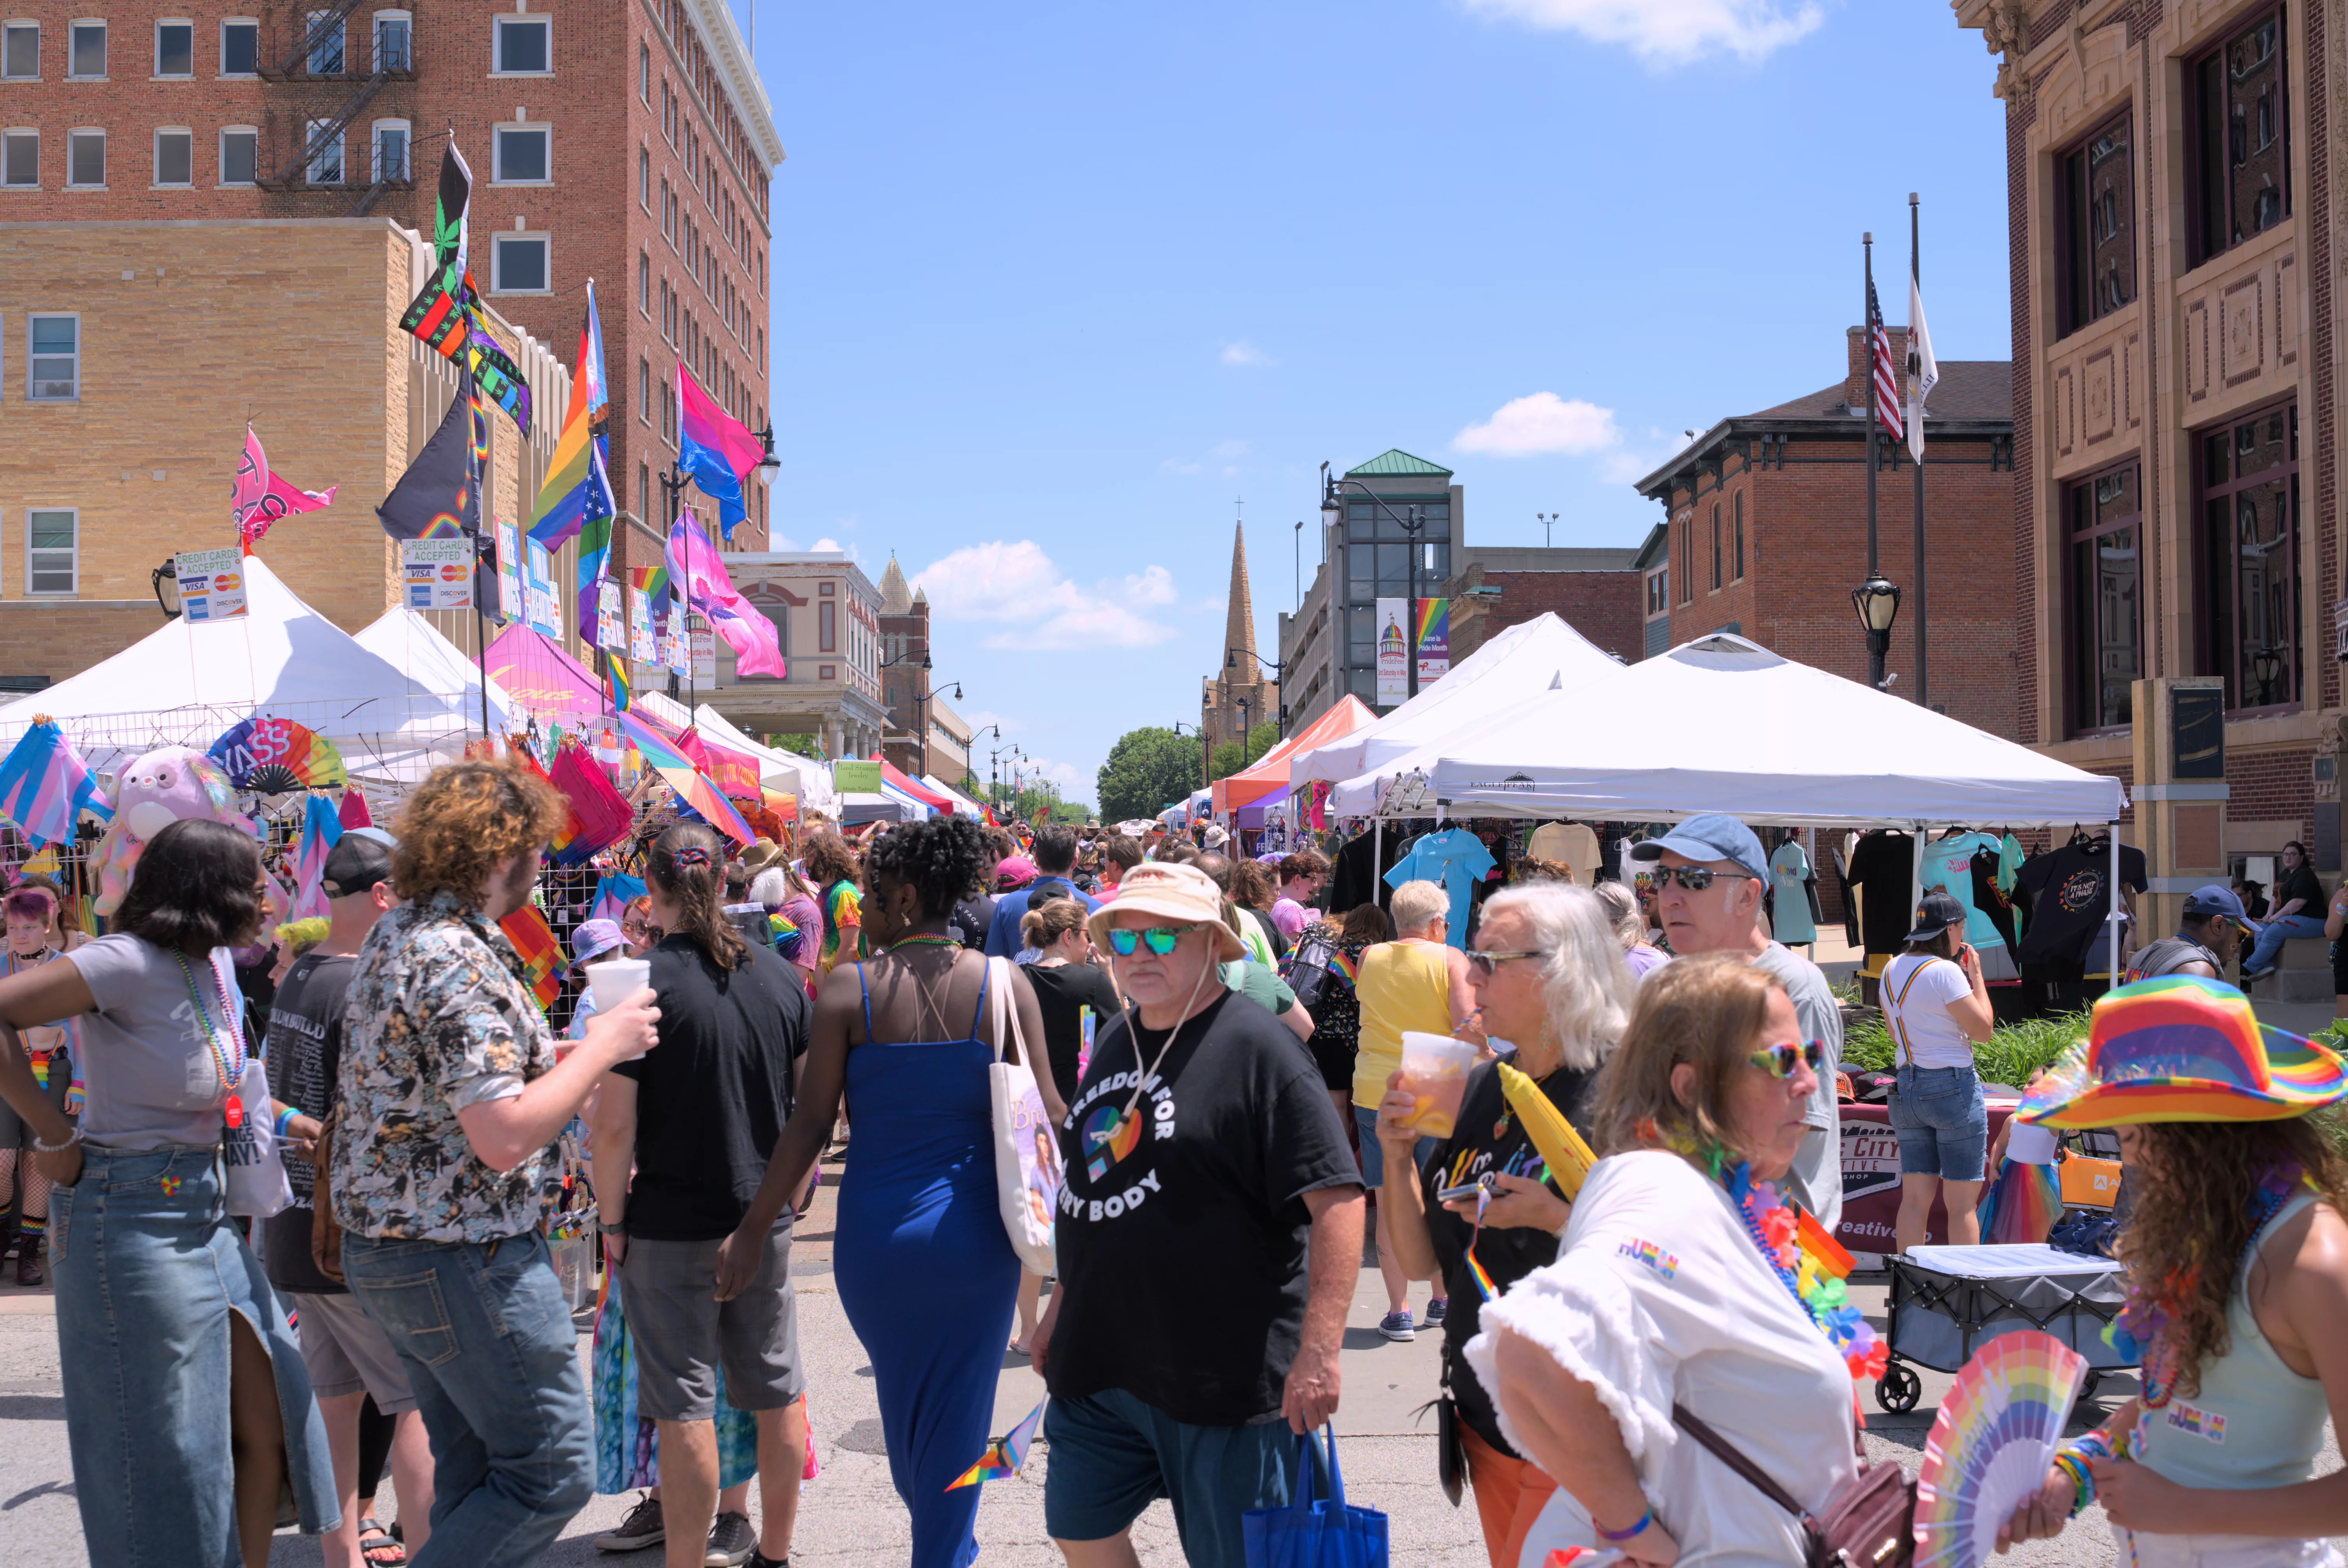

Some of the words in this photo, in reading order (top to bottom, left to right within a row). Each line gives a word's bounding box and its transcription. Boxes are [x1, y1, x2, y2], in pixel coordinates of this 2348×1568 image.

[406, 541, 437, 550] CREDIT
[440, 540, 468, 550] CARDS
[498, 521, 517, 568] FREE
[177, 553, 207, 565] CREDIT
[209, 549, 238, 561] CARDS
[415, 551, 460, 560] ACCEPTED
[187, 561, 231, 574] ACCEPTED
[185, 582, 205, 591] VISA
[500, 571, 522, 618] HUGS
[691, 634, 711, 643] ideFest
[1384, 669, 1396, 677] Saturday
[211, 726, 290, 777] YASS
[2071, 884, 2082, 892] IT'S
[2083, 881, 2096, 890] NOT
[2075, 888, 2093, 898] PHASE
[964, 909, 979, 926] FACE
[1011, 1099, 1050, 1129] Bren
[1151, 1086, 1175, 1141] FOR
[1089, 1168, 1162, 1222] BODY
[1619, 1234, 1678, 1280] HUMAN
[2169, 1403, 2224, 1440] HUMAN
